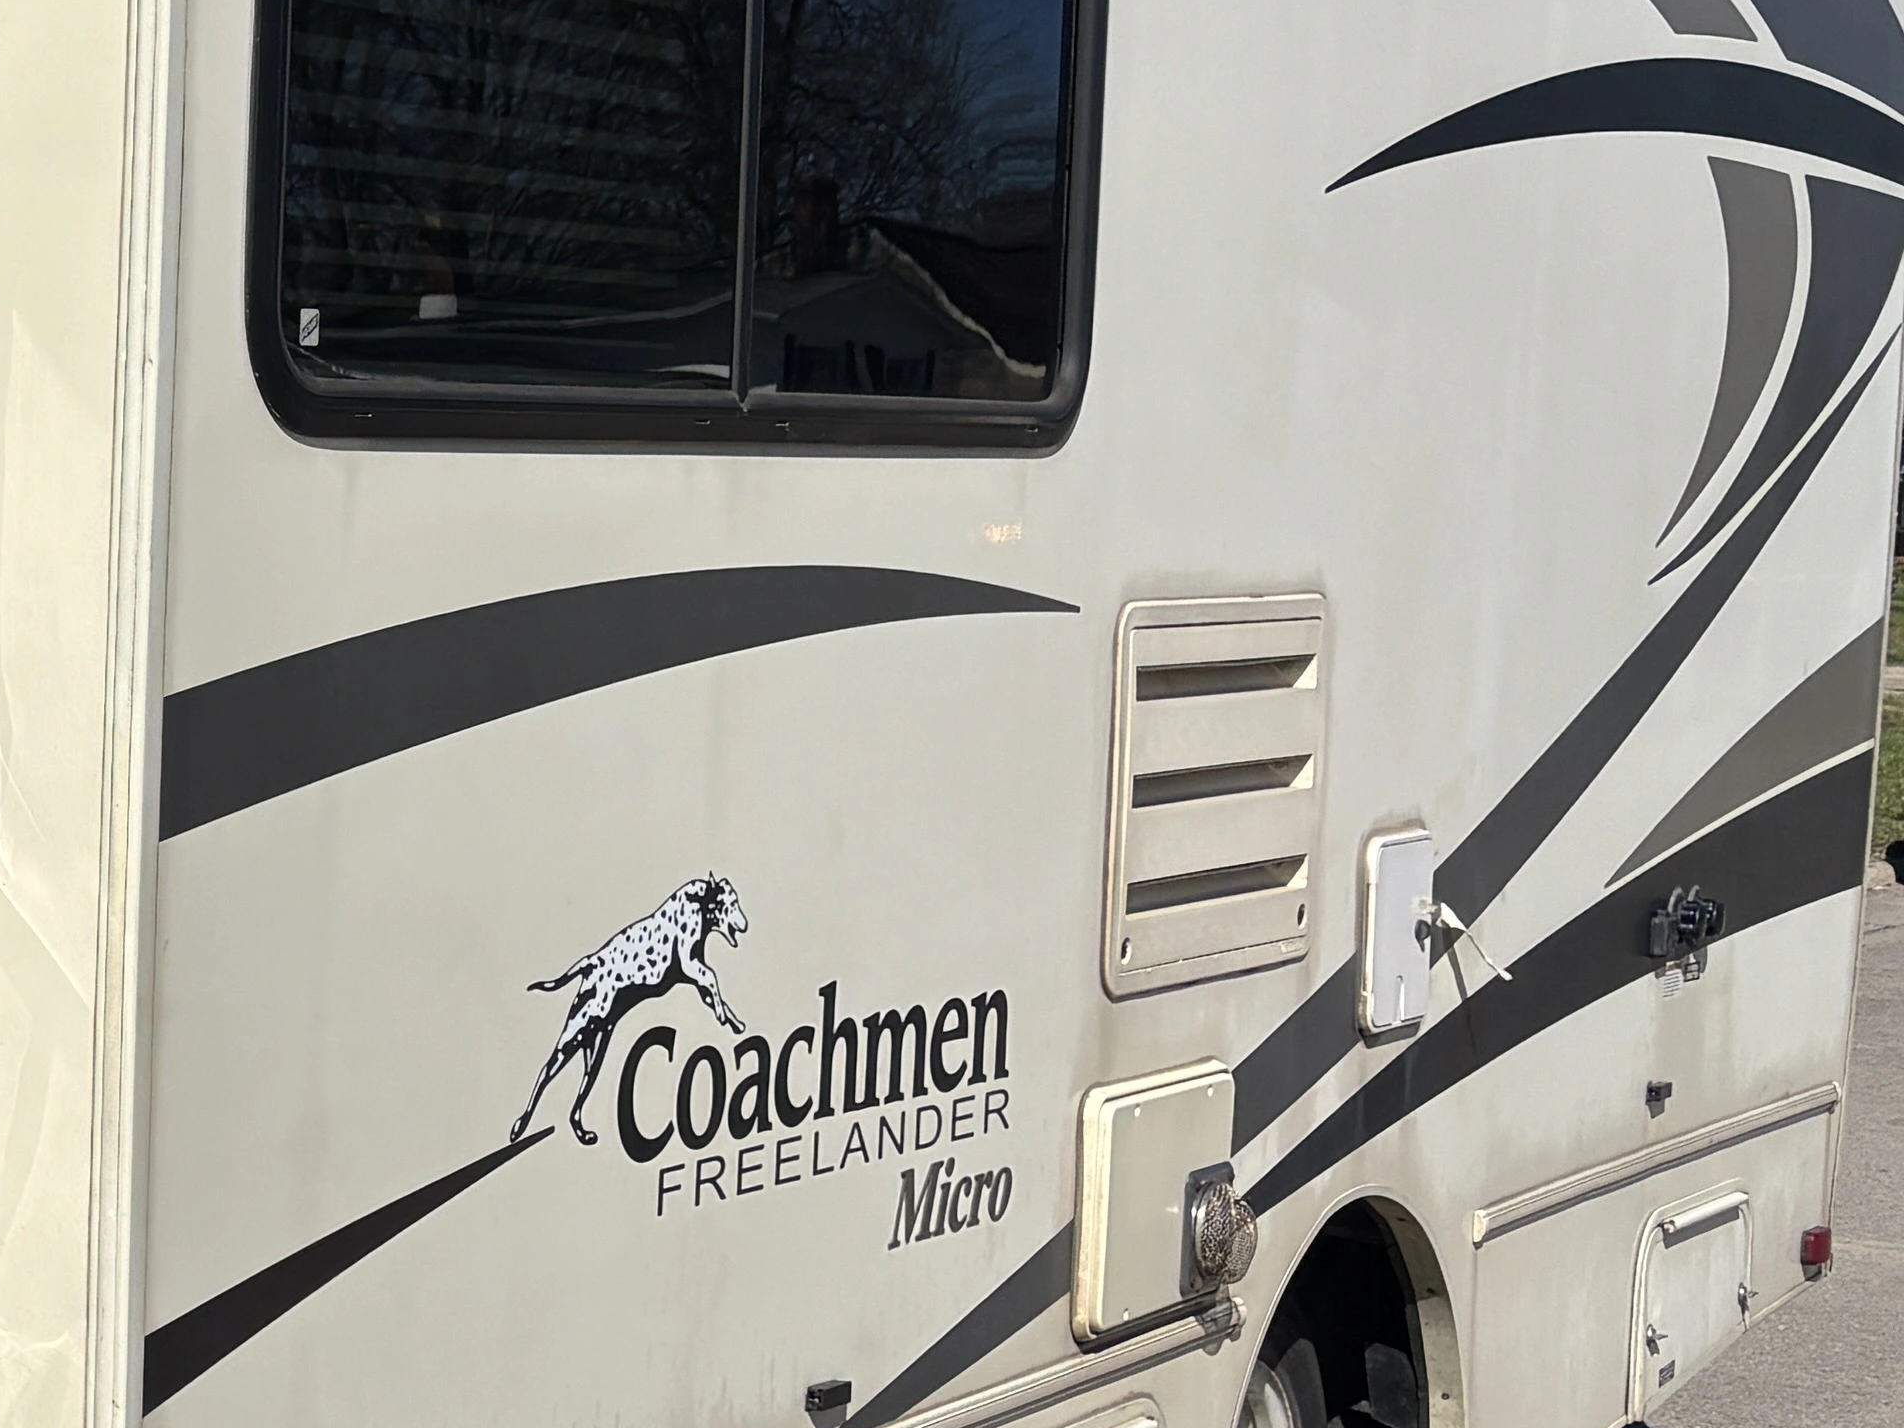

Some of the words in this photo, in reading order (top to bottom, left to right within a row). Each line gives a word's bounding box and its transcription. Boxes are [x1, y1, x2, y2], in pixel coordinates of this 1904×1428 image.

[616, 980, 1010, 1164] Coachmen
[656, 1088, 1011, 1217] FREELANDER
[886, 1156, 1013, 1251] Micro
